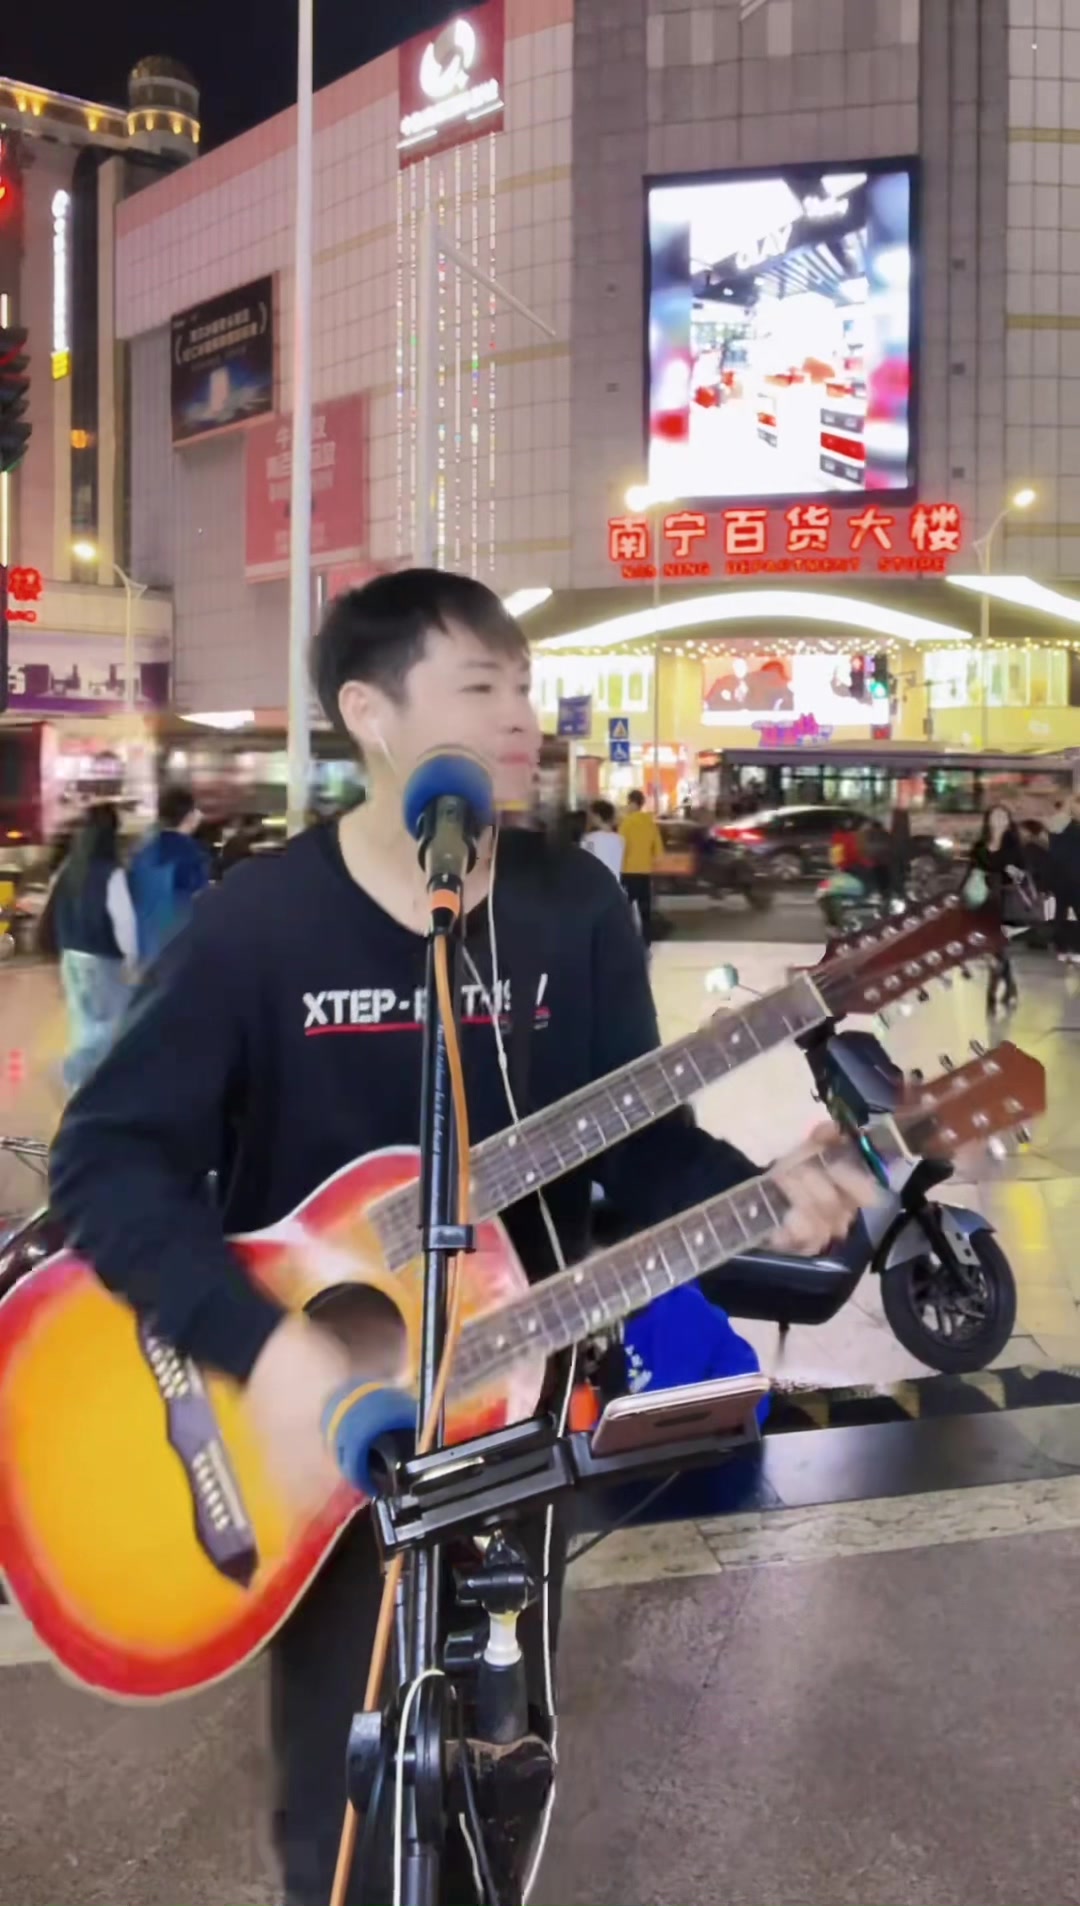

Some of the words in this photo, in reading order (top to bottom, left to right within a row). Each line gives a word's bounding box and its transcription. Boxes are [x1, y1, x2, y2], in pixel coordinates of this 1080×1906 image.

[607, 504, 961, 562] 南宁百货大楼
[878, 555, 946, 572] STORE
